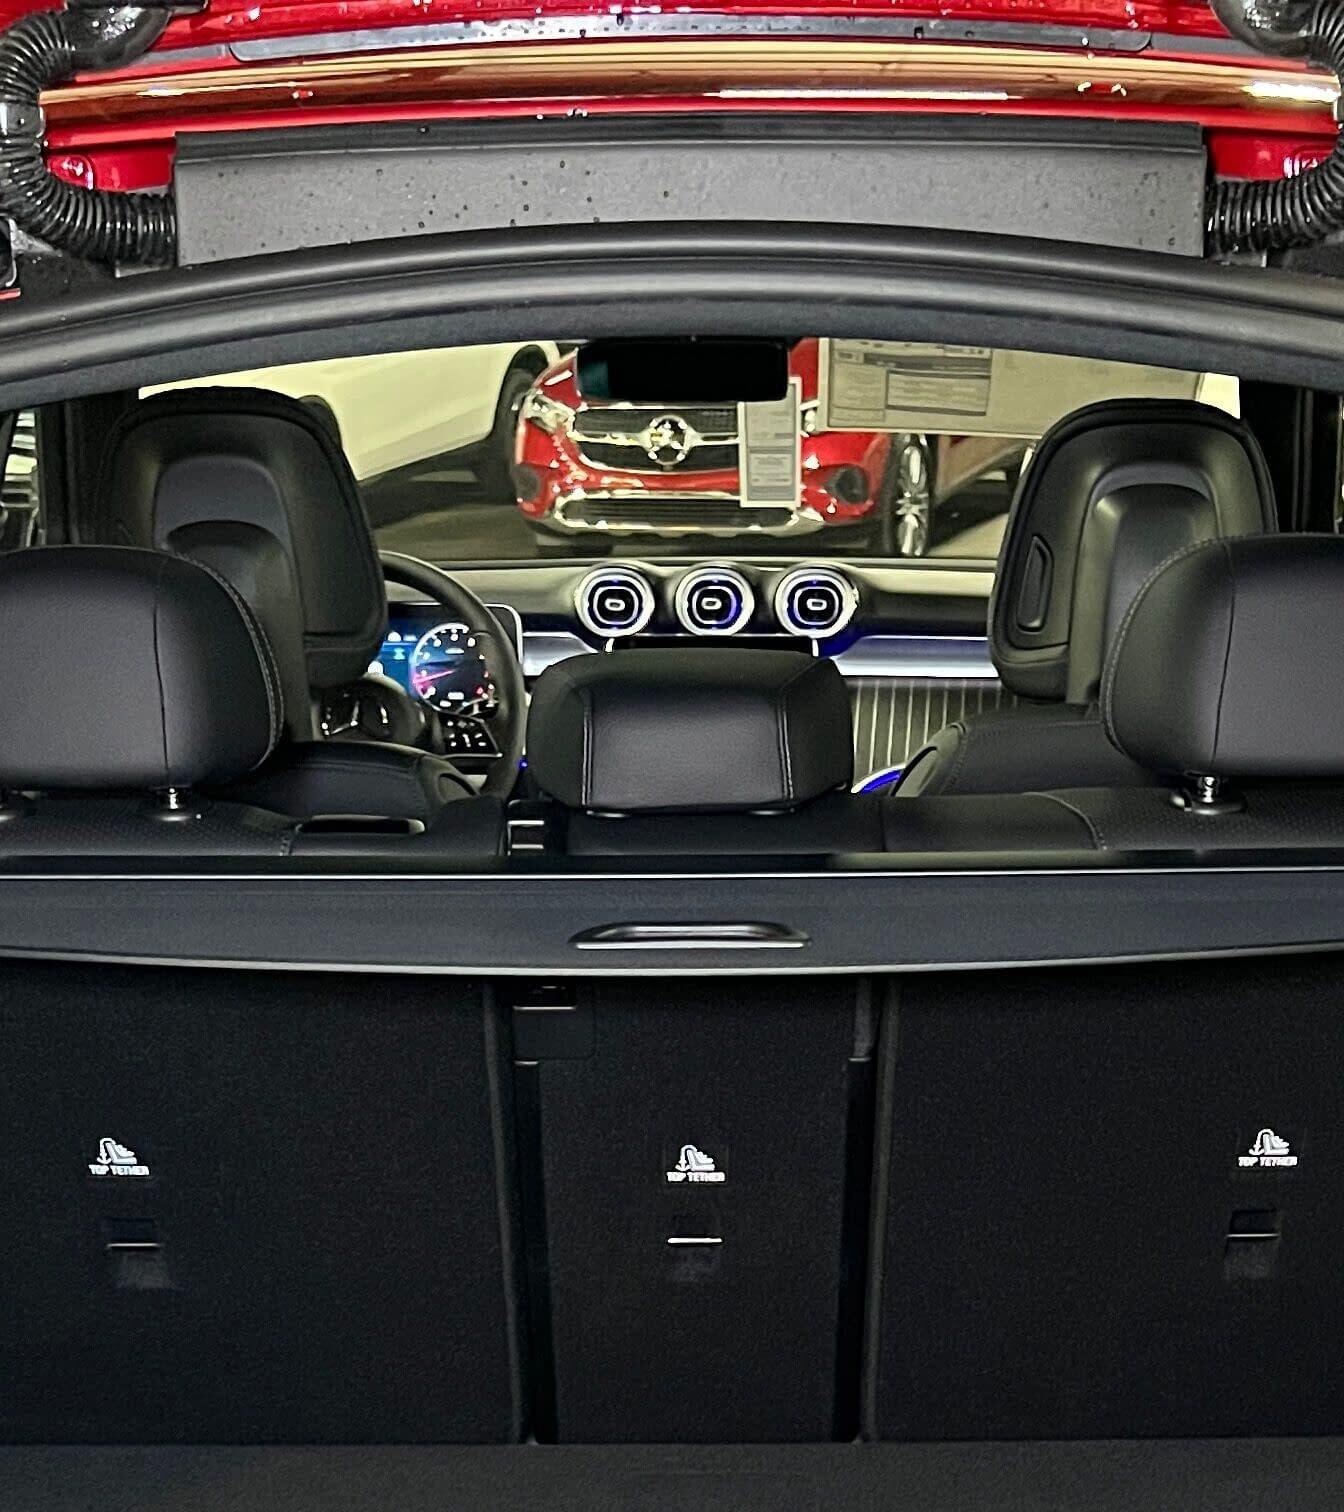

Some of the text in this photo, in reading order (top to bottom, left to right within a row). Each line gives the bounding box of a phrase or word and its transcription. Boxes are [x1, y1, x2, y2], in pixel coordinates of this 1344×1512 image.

[1238, 1156, 1298, 1166] TOP TETHER
[88, 1164, 150, 1175] TOP TETHER
[666, 1172, 726, 1182] TOP TETHER
